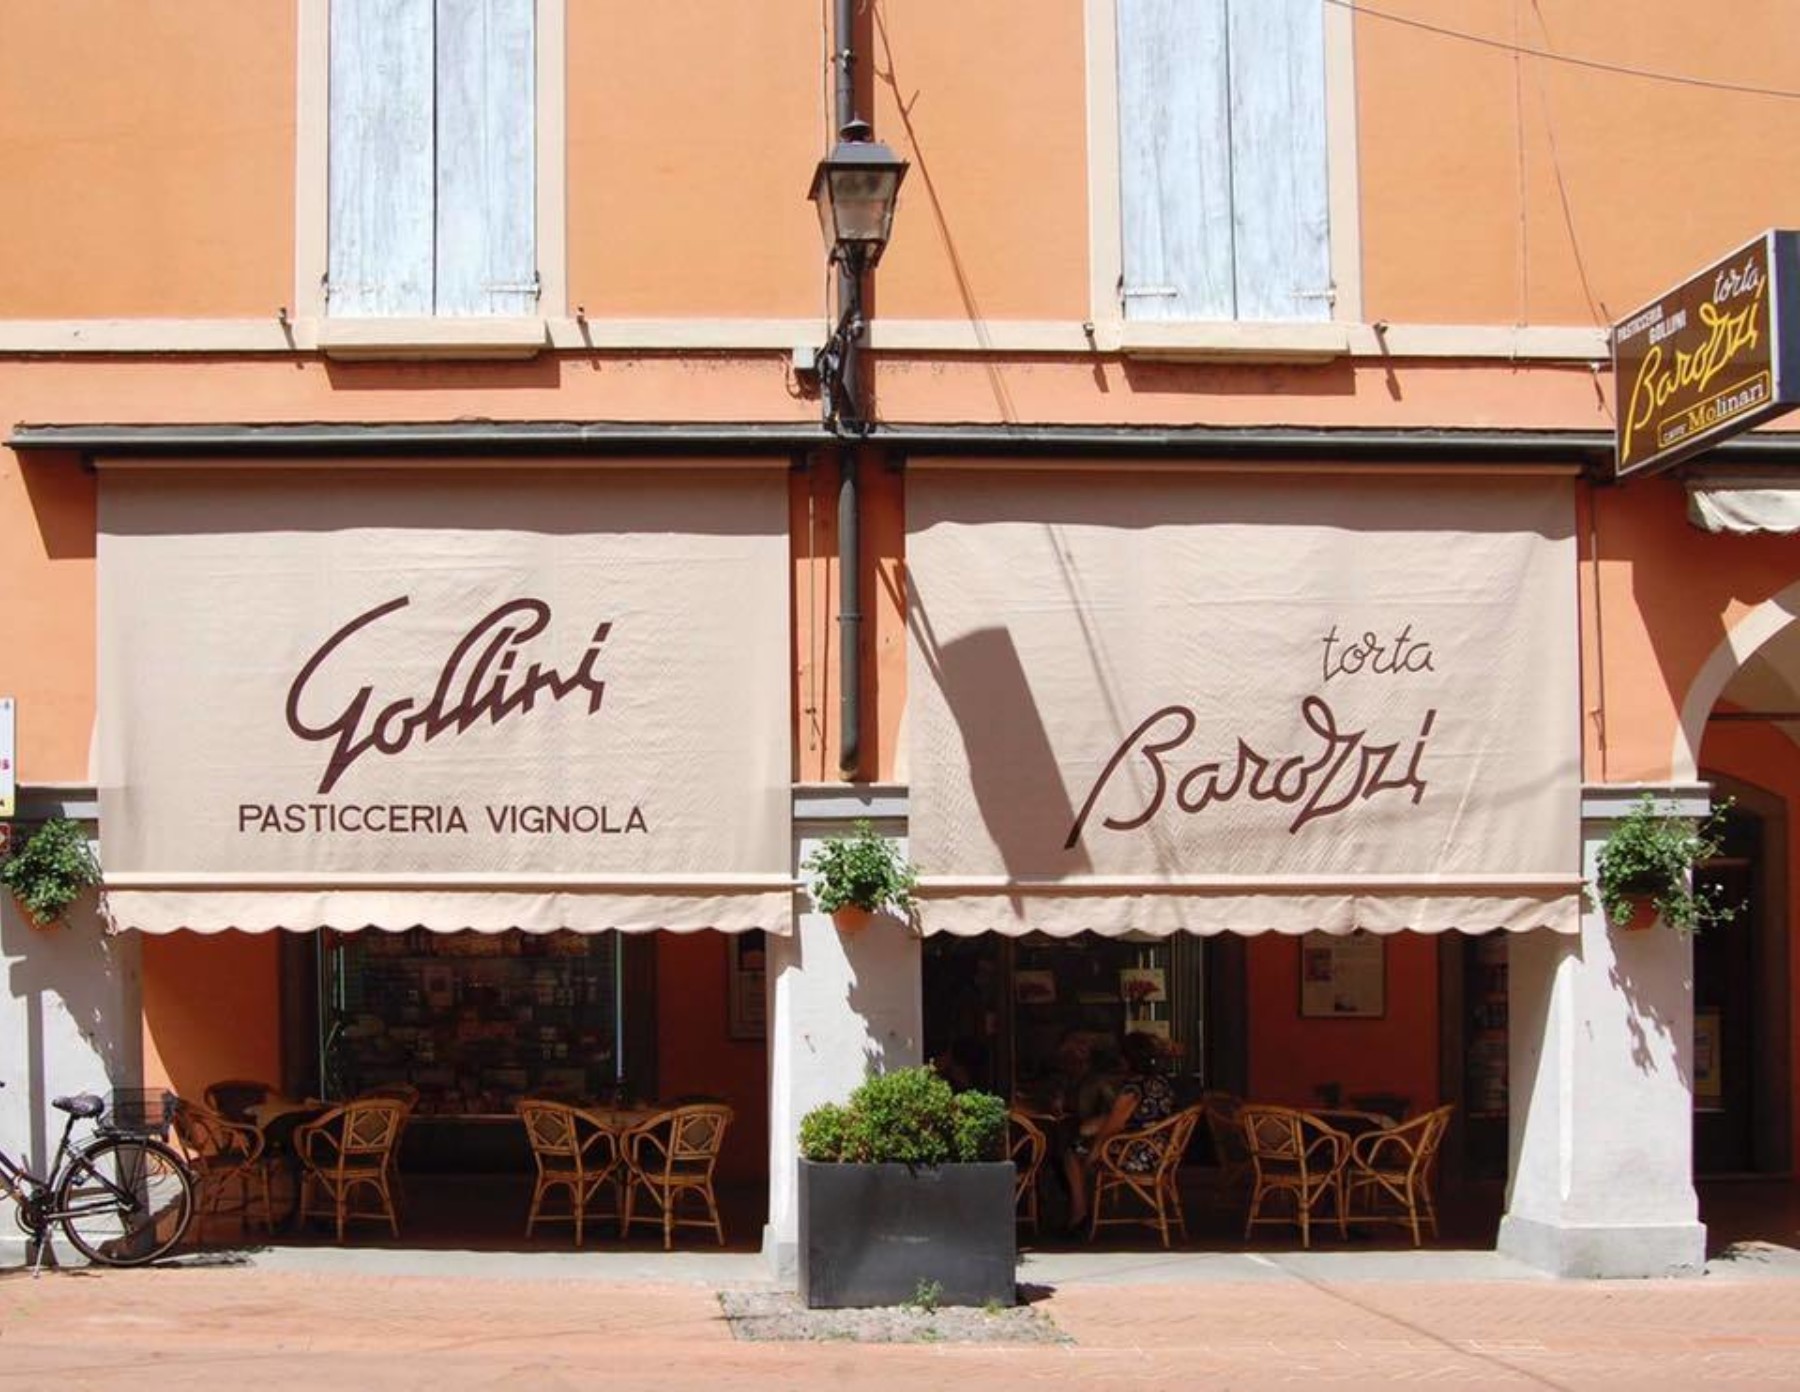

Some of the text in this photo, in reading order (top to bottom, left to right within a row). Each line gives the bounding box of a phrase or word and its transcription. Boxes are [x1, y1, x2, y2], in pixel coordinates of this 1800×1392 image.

[1713, 257, 1759, 304] torta
[1622, 274, 1766, 463] Barozzi
[1688, 379, 1763, 433] Molinari
[1323, 625, 1434, 681] torta
[286, 595, 613, 794] Gollini
[1064, 695, 1437, 849] Barozzi
[239, 804, 648, 833] PASTICCERIA VIGNOLA
